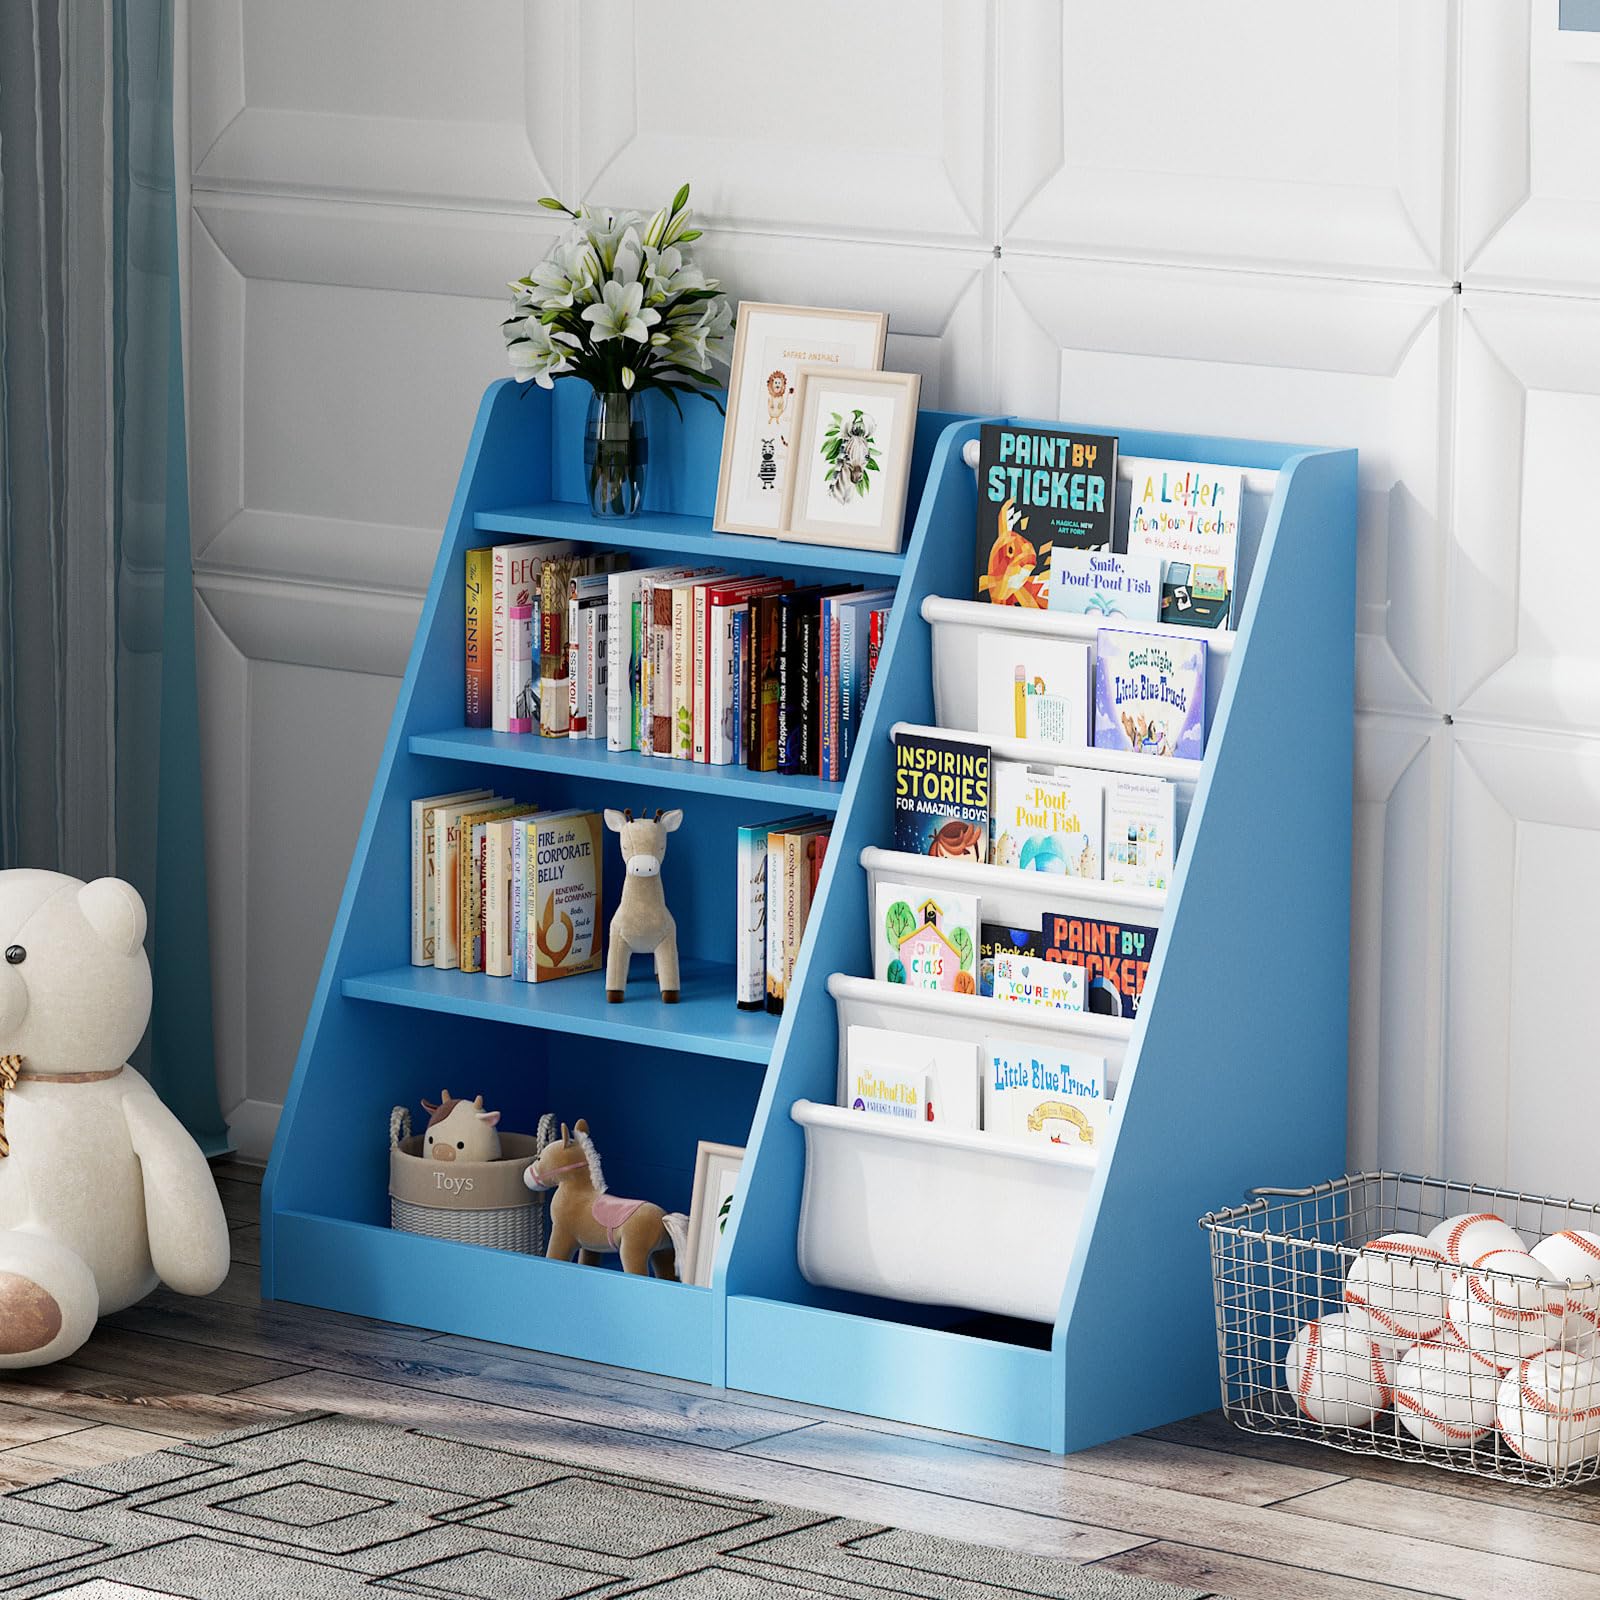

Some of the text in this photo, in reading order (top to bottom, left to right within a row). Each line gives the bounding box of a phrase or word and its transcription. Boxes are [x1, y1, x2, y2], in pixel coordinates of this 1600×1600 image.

[1000, 432, 1097, 469] PAINT BY
[988, 465, 1105, 513] STICKER
[1143, 472, 1225, 507] A Letter
[1056, 519, 1079, 528] MAGICAL
[1080, 521, 1094, 529] NEW
[1070, 528, 1086, 536] FORM
[1187, 510, 1236, 535] Teacher
[1089, 556, 1125, 573] Smile,
[1061, 570, 1151, 594] Pout-Pout Fish
[695, 597, 704, 607] IN
[466, 604, 478, 663] SENSE
[544, 616, 551, 628] OF
[695, 609, 704, 643] PURSUIT
[674, 603, 682, 687] UNITED IN PRAYER
[696, 645, 703, 655] OF
[587, 654, 593, 663] OF
[1128, 648, 1148, 669] Good
[695, 658, 704, 688] PROFIT
[842, 688, 850, 720] НАШИ
[1115, 674, 1186, 713] Little Blue Truck
[473, 701, 479, 714] TO
[778, 711, 787, 747] Zeppelin
[897, 745, 988, 779] INSPIRING
[896, 768, 988, 807] STORIES
[896, 797, 987, 822] FOR AMAZING BOYS
[1016, 806, 1080, 833] Pout Fish
[538, 831, 575, 848] FIRE in the
[537, 842, 590, 865] CORPORATE
[514, 862, 521, 875] OF
[538, 865, 565, 883] BELLY
[555, 884, 584, 895] RENEWING
[555, 896, 564, 904] the
[1053, 917, 1145, 956] PAINT BY
[1009, 982, 1049, 998] YOU'RE
[1051, 988, 1069, 1001] MY
[994, 1058, 1028, 1090] Little
[1031, 1059, 1059, 1092] Blue
[432, 1172, 474, 1195] Toys
